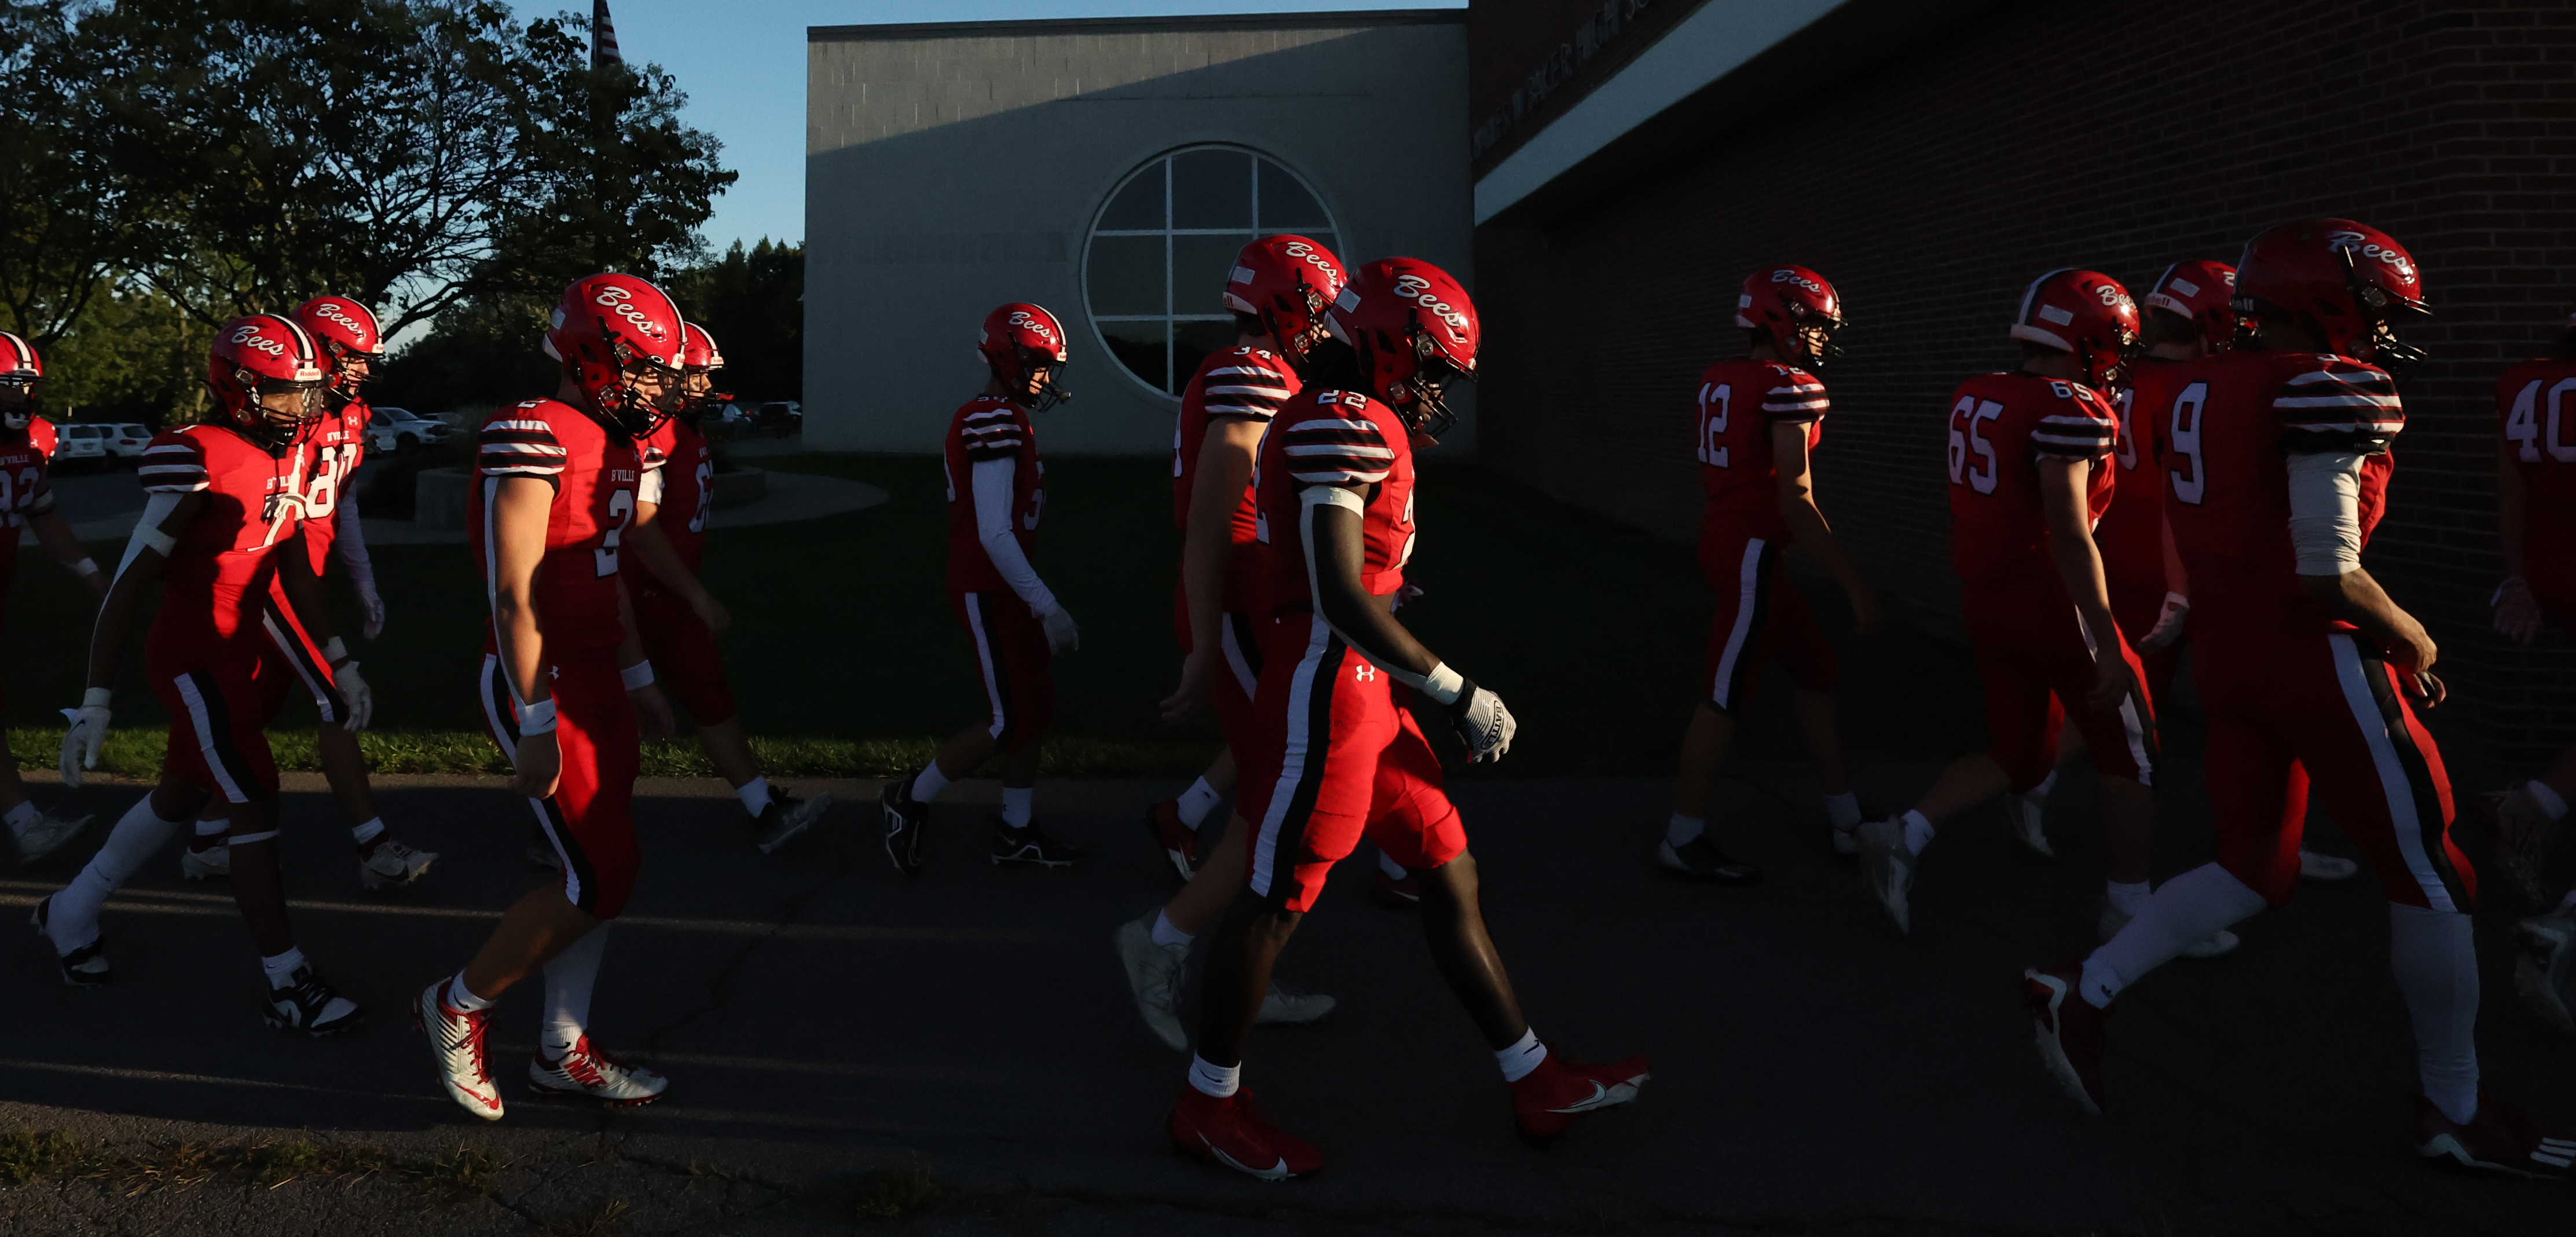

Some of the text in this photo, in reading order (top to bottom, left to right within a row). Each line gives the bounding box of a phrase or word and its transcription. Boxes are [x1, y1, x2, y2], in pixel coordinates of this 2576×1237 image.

[1286, 241, 1337, 285] Bees
[2324, 230, 2409, 274] Bees
[1393, 275, 1460, 327] Bees
[1771, 269, 1821, 292] Bees
[316, 303, 360, 332] Bees
[596, 286, 654, 334] Bees
[1009, 311, 1050, 338] Bees
[231, 325, 284, 356] Bees
[2050, 382, 2094, 402] 65
[1698, 382, 1732, 469] 12
[2505, 377, 2576, 463] 40
[1948, 396, 2005, 496] 65
[2171, 382, 2208, 505] 9
[611, 470, 635, 482] B'VILLE
[594, 489, 634, 577] 2
[1483, 707, 1502, 746] BATTLE
